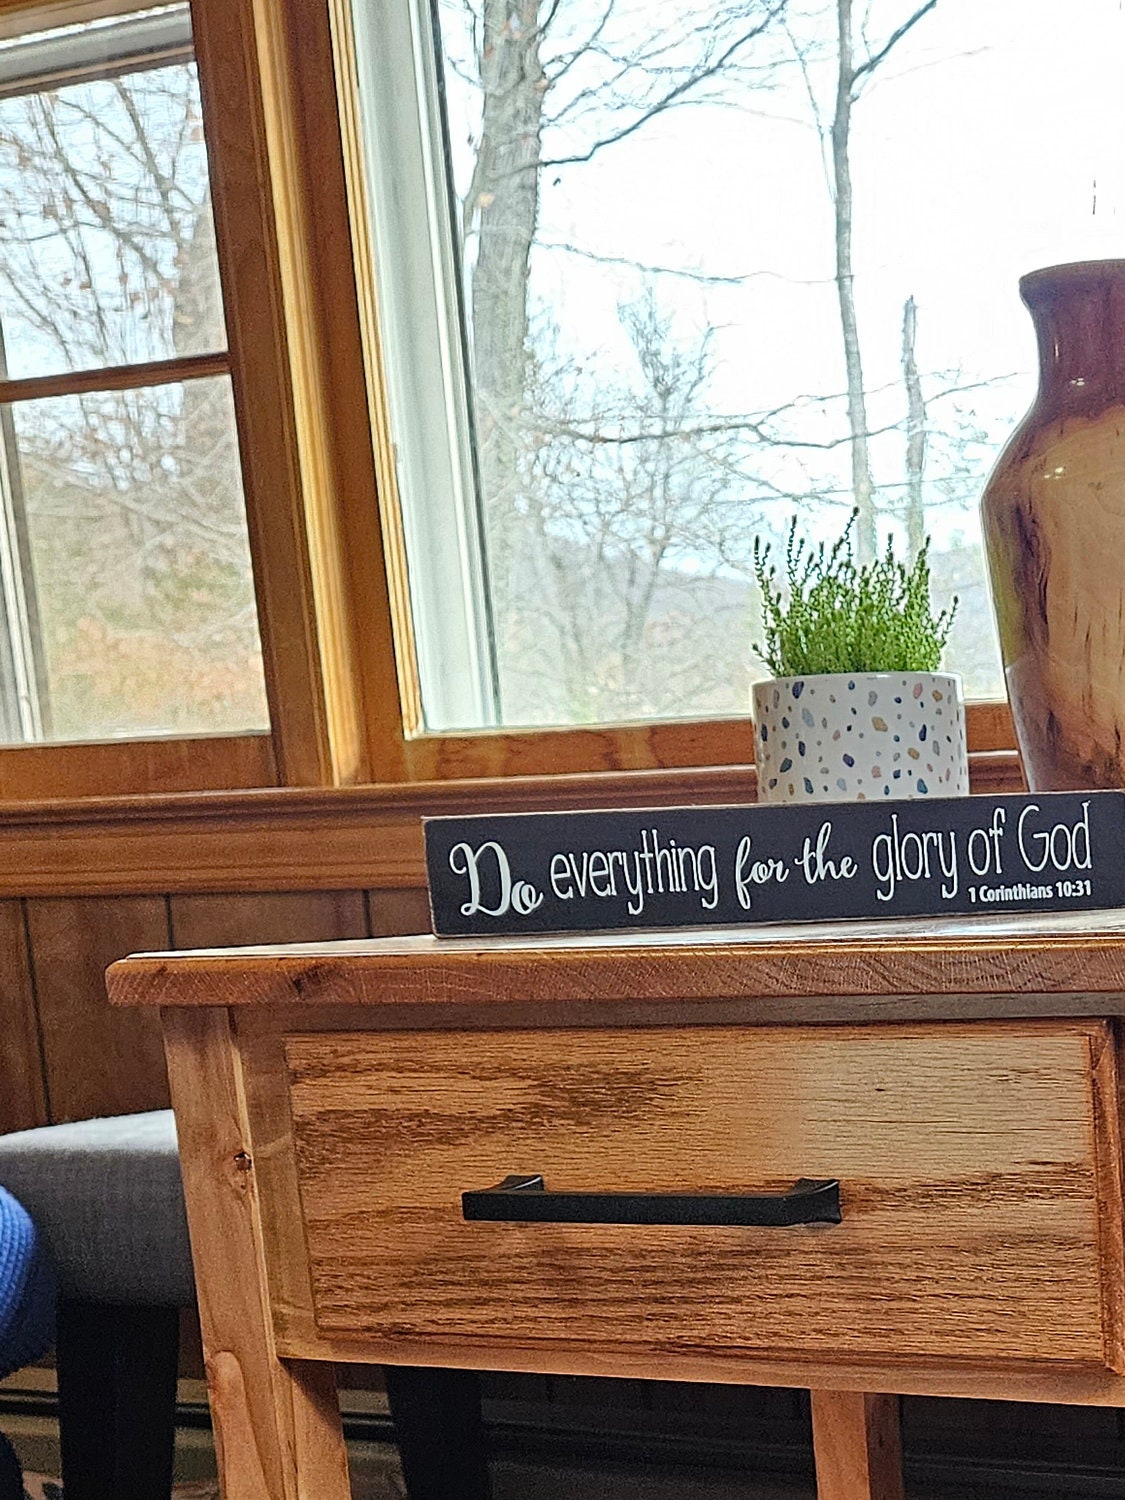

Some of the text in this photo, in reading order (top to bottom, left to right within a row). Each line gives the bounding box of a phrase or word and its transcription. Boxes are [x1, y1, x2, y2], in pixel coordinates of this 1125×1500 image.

[450, 801, 1092, 916] Do everything for the glory of God
[968, 880, 1091, 903] 1 Corinthians 10:31
